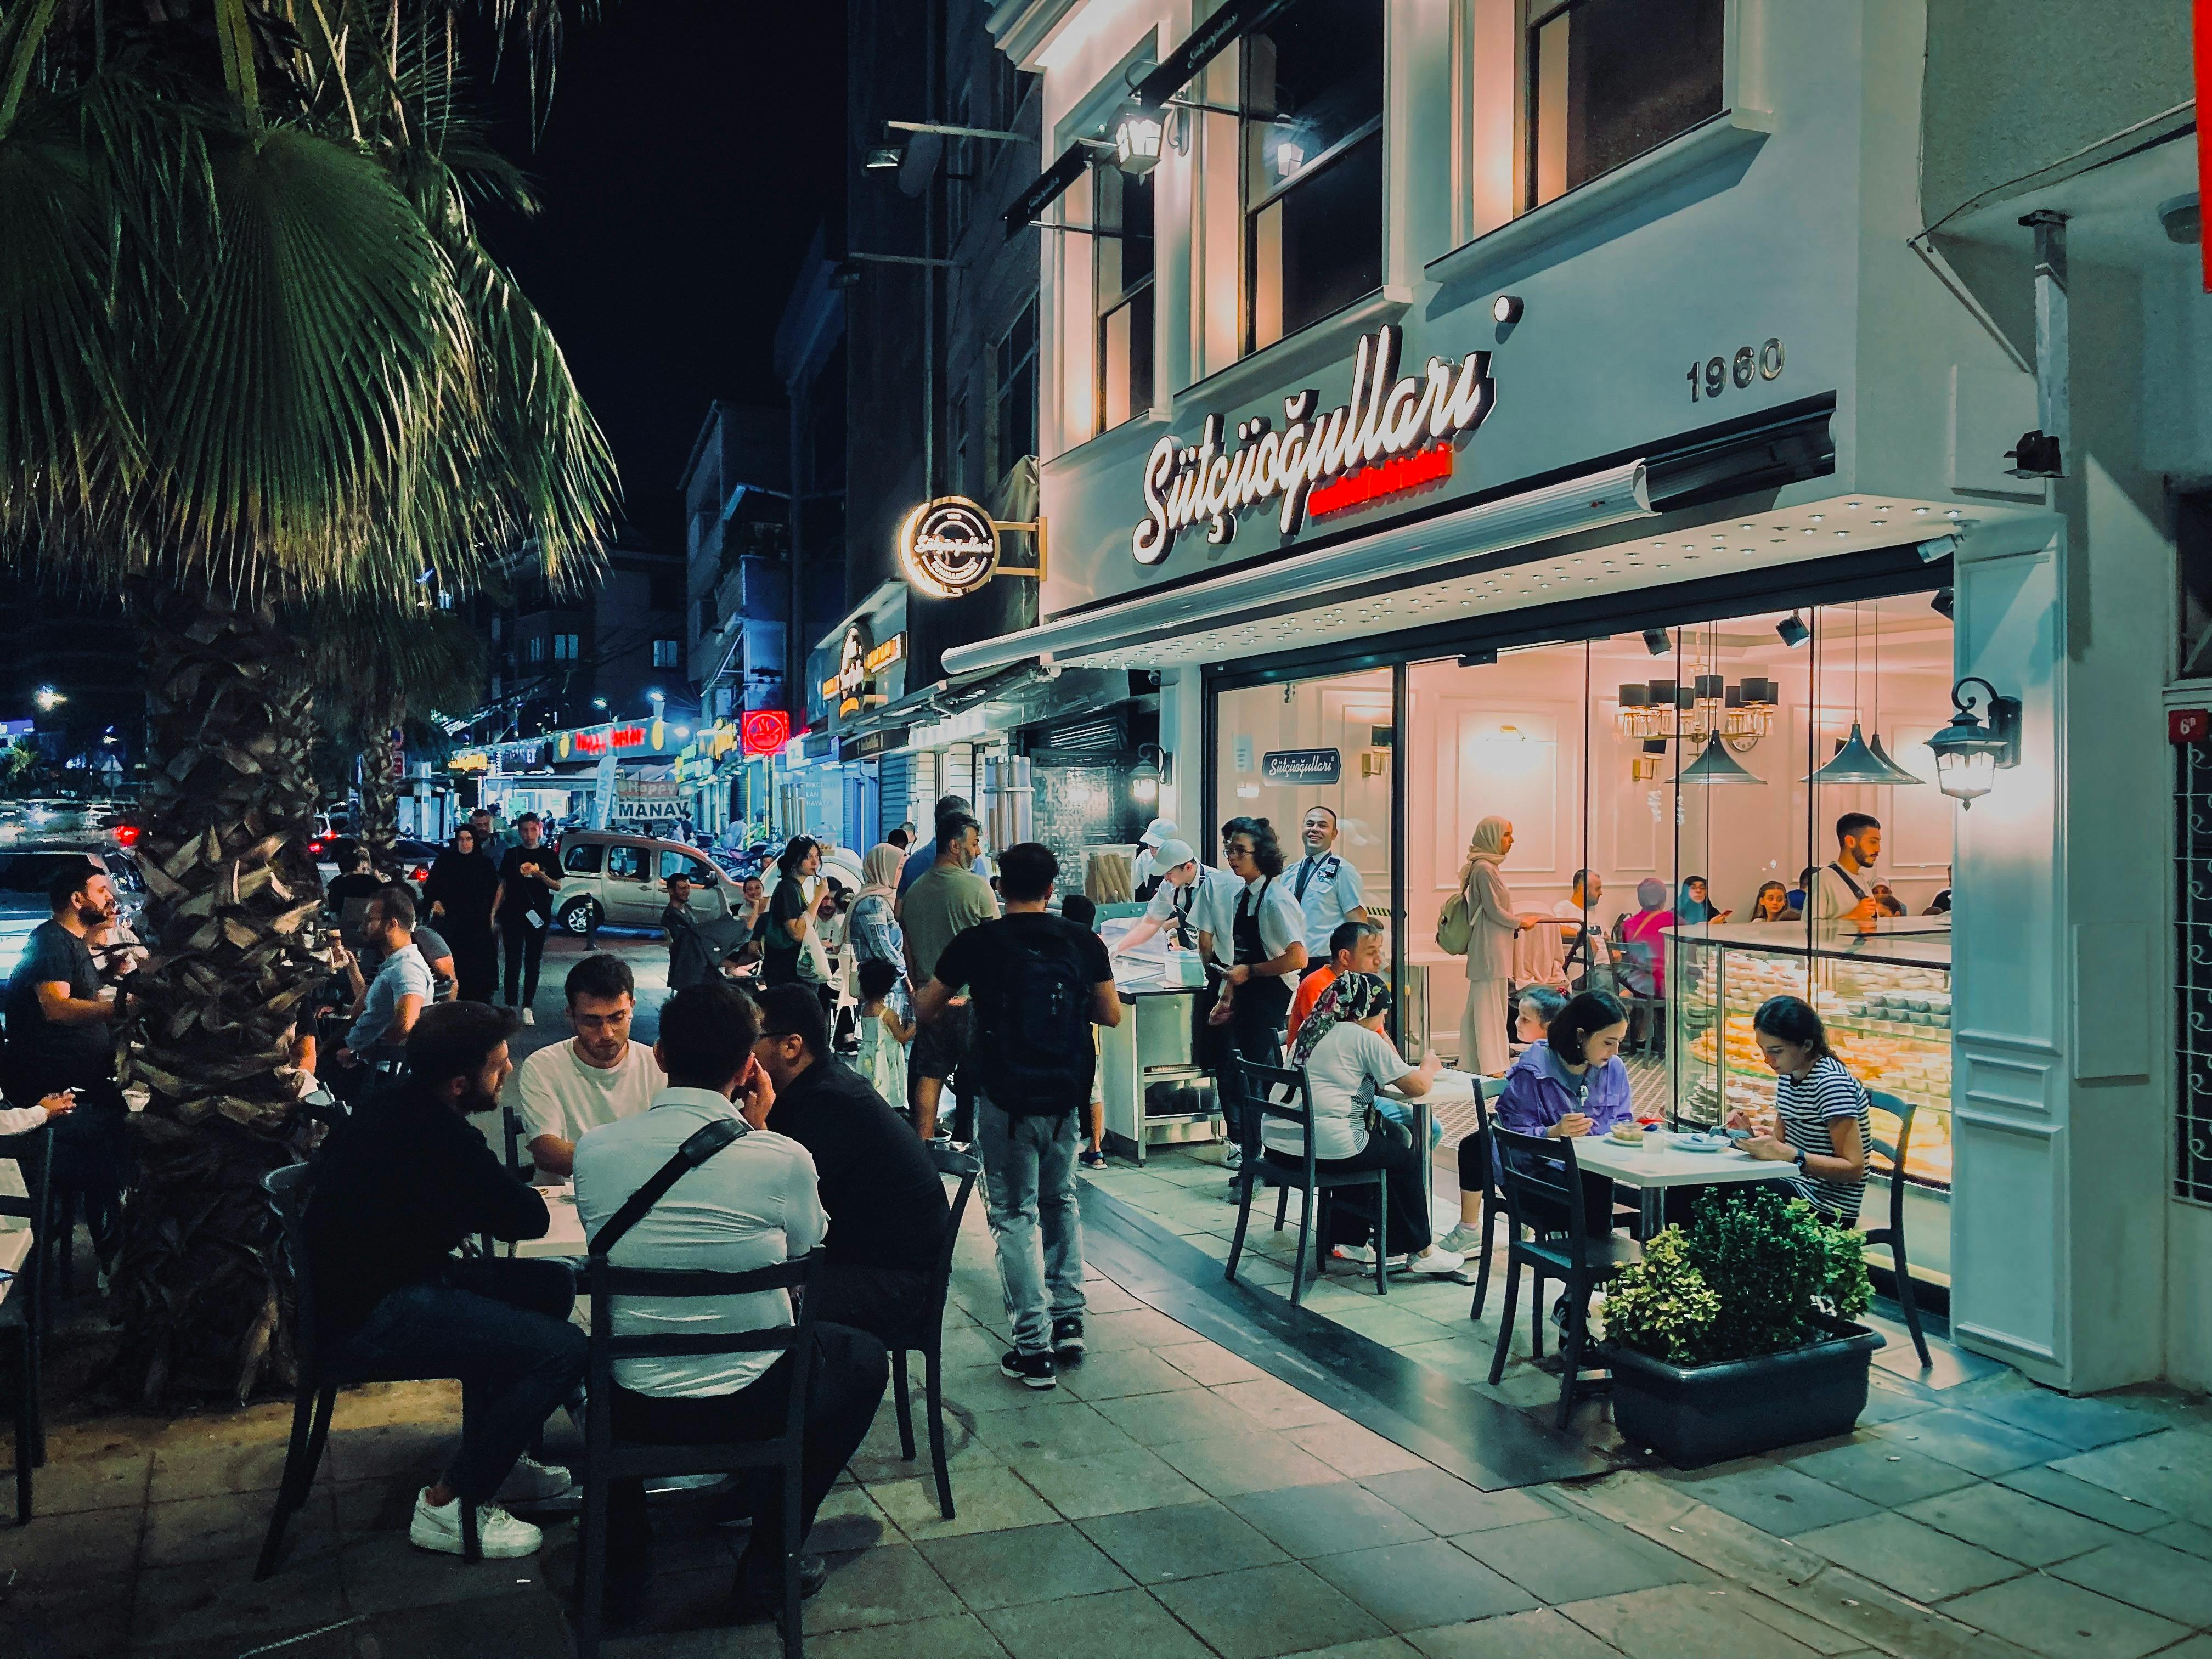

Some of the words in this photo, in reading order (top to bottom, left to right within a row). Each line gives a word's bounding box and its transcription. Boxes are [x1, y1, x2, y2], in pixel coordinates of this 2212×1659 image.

[1686, 337, 1785, 403] 1960
[1132, 325, 1495, 565] Sütçüoğulları
[1268, 755, 1332, 778] Sütçüoğulları
[619, 802, 689, 817] MANAV
